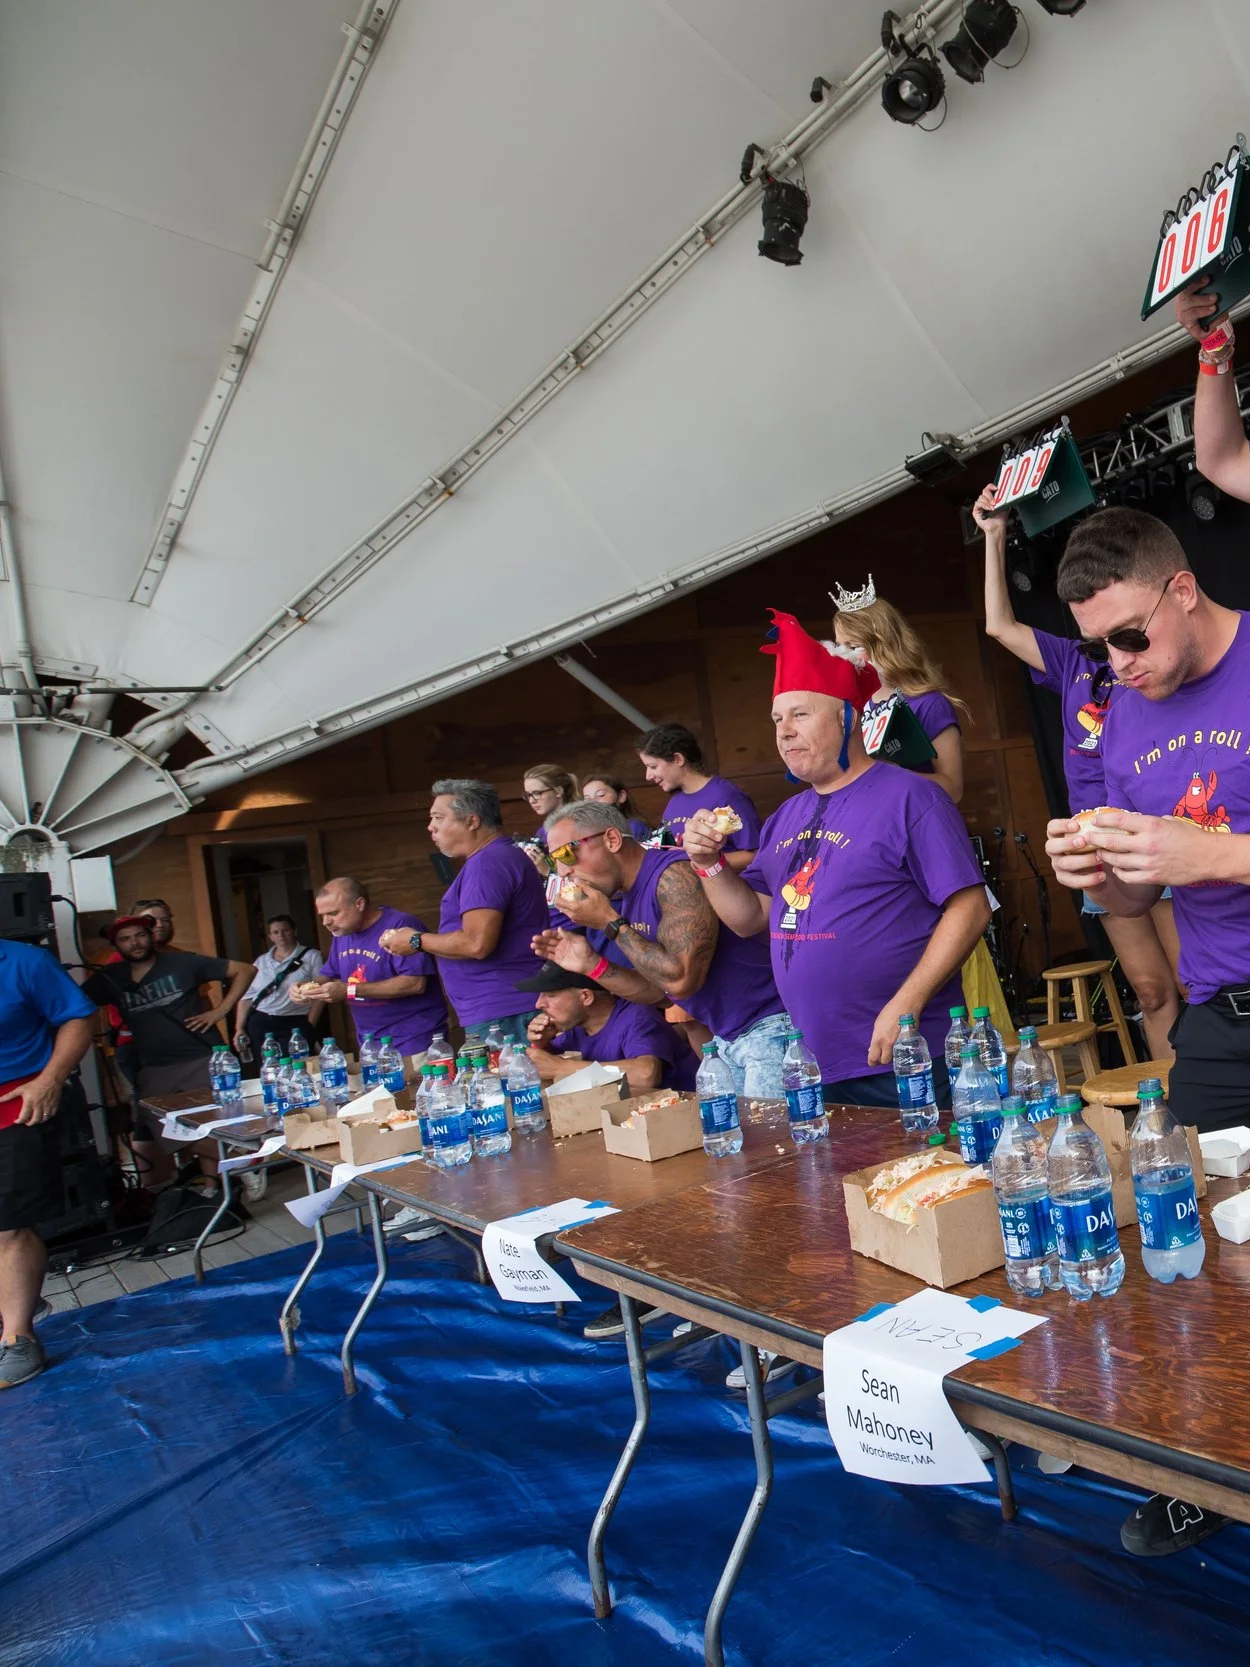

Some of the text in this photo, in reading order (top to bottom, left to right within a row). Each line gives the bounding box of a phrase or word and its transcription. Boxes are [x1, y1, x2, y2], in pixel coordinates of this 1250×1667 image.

[1158, 188, 1228, 293] 006
[995, 448, 1051, 504] 009
[1041, 480, 1060, 499] CATO
[884, 738, 901, 753] CATO
[1133, 746, 1161, 775] I'm
[1168, 734, 1186, 752] on
[1194, 729, 1203, 744] a
[1208, 728, 1242, 750] roll
[797, 829, 811, 841] on
[815, 829, 822, 839] a
[824, 830, 844, 845] roll
[807, 931, 837, 940] FESTIVAL
[379, 1077, 394, 1085] ANI
[514, 1092, 541, 1105] DASAN
[1027, 1107, 1055, 1124] ASAN
[432, 1124, 449, 1135] ANI
[1086, 1201, 1114, 1233] DAS
[499, 1238, 520, 1258] Nate
[499, 1263, 548, 1283] Gayman
[861, 1368, 900, 1405] Sean
[846, 1404, 934, 1451] Mahoney
[859, 1441, 936, 1465] Worchester, MA
